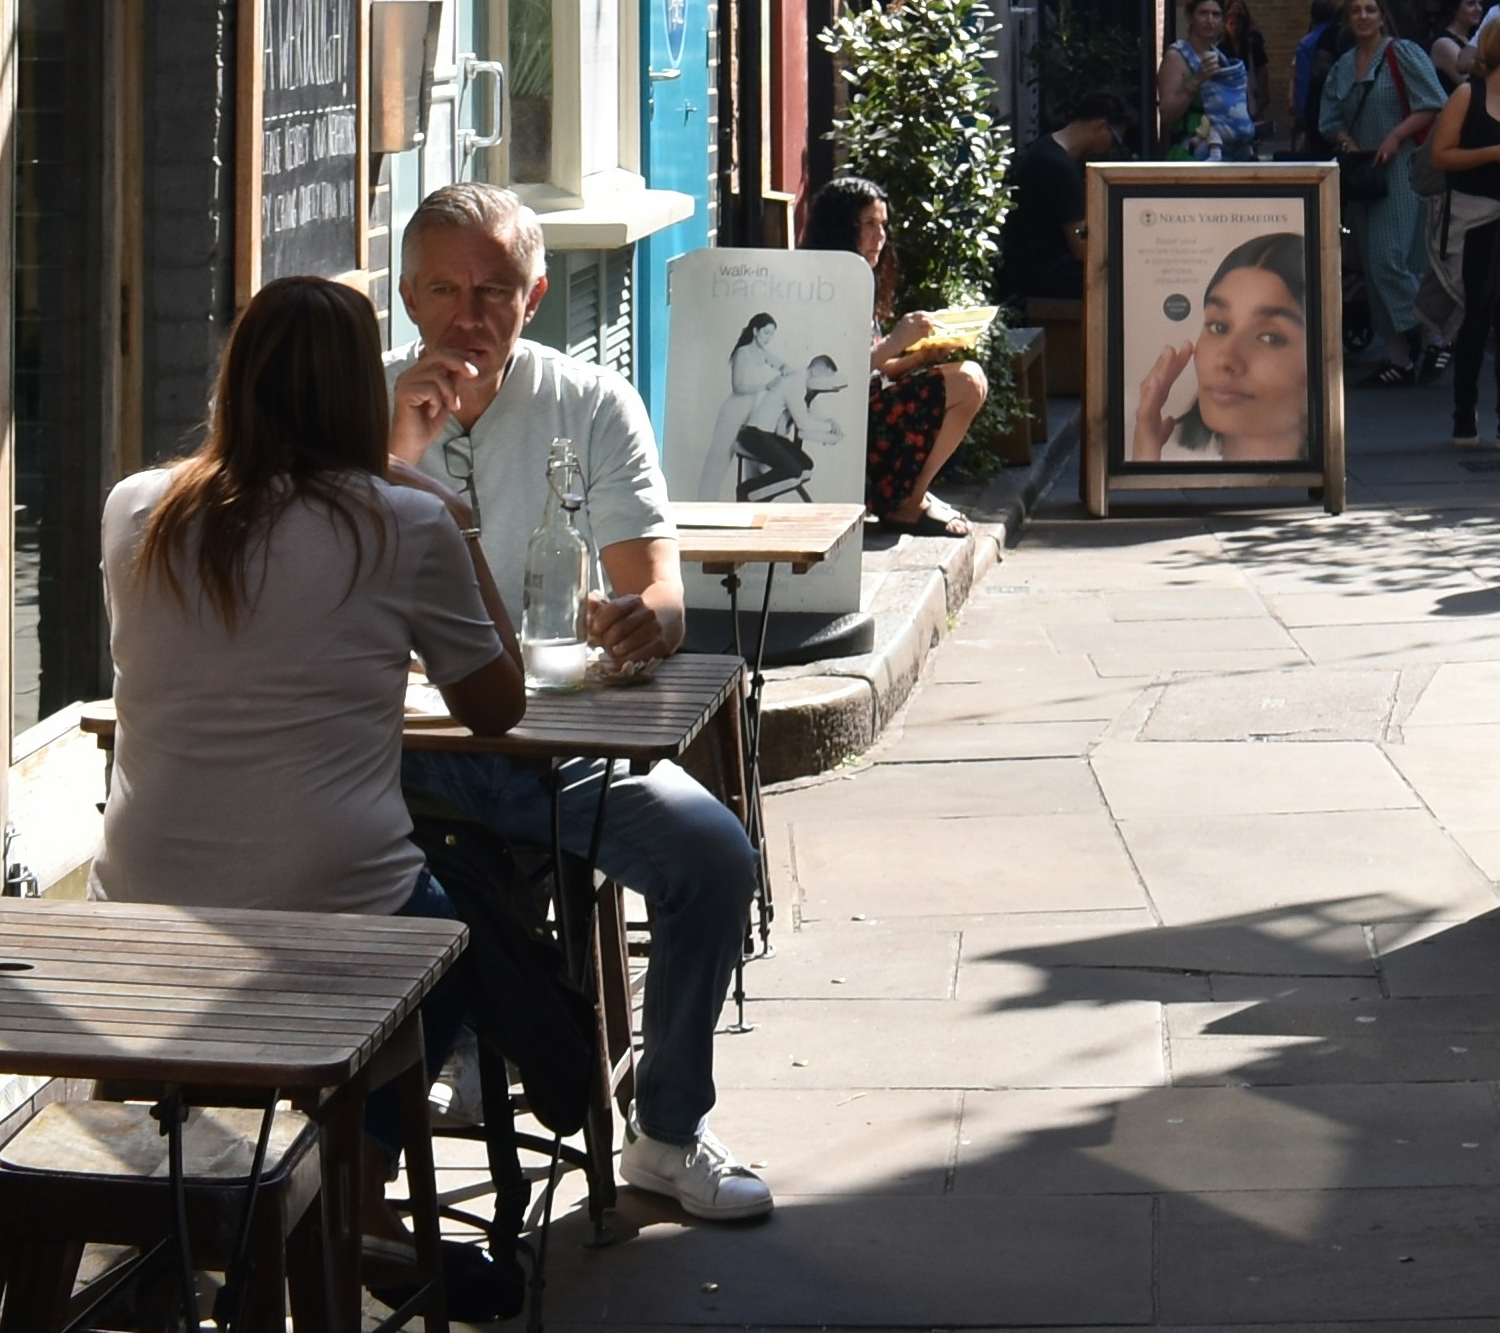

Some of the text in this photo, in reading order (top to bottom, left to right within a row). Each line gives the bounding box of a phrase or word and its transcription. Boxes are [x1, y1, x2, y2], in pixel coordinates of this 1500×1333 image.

[1198, 212, 1228, 223] YARD
[1230, 212, 1289, 223] REMEDIES
[719, 264, 769, 278] walk-in
[711, 272, 836, 303] backrub
